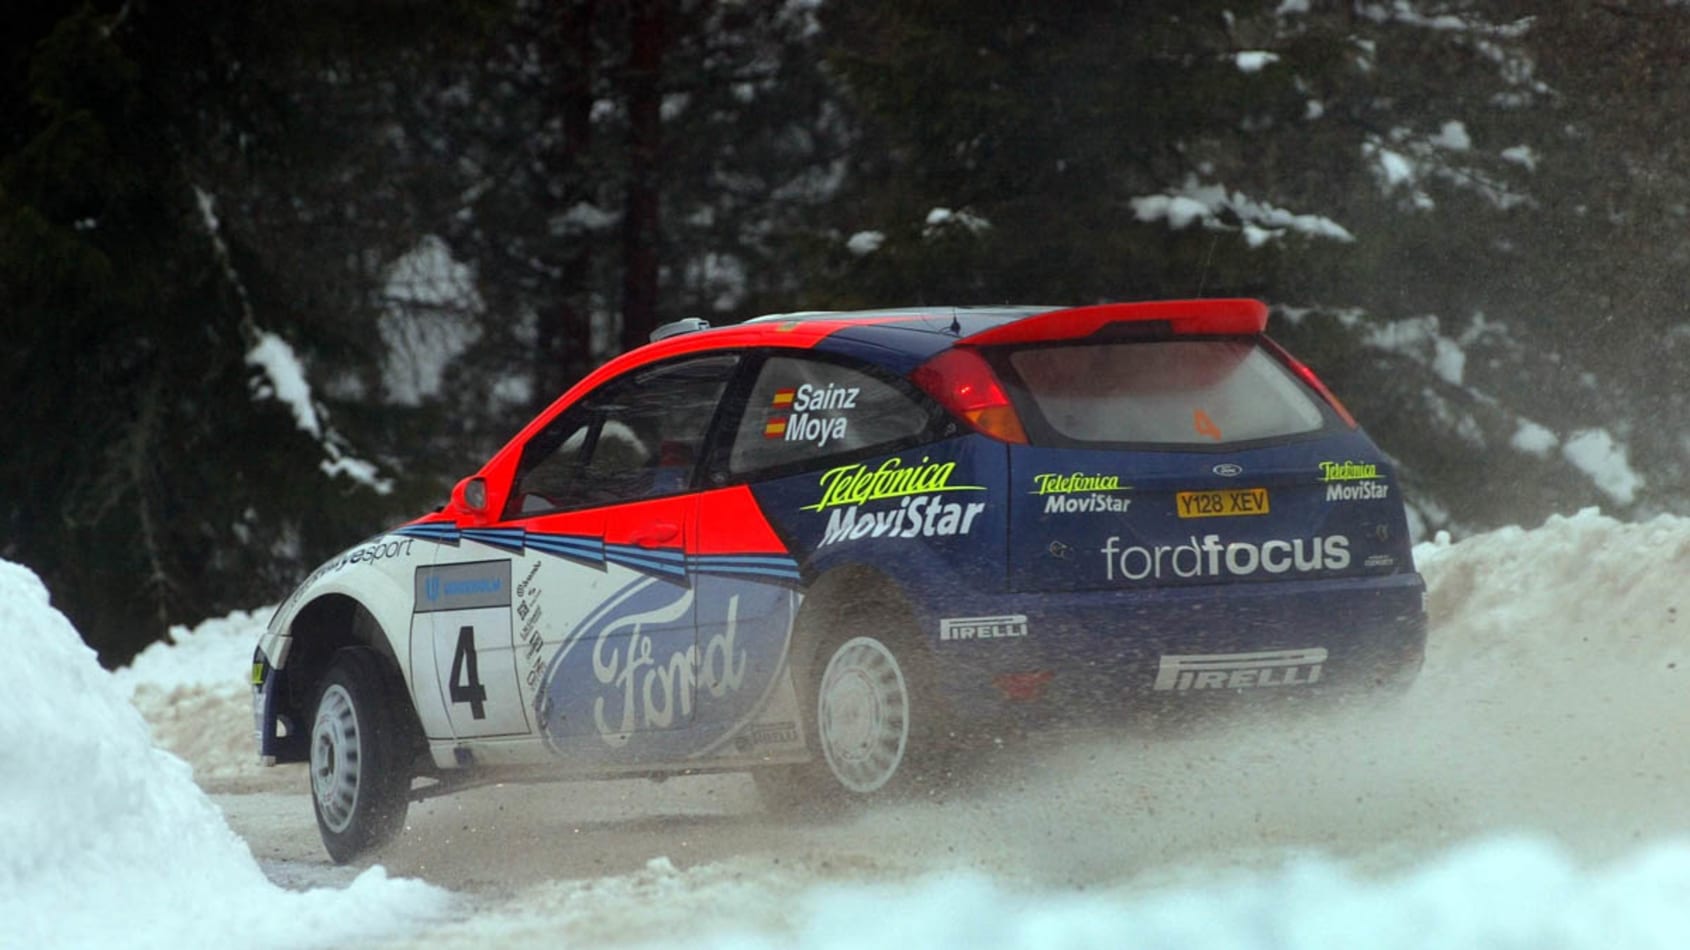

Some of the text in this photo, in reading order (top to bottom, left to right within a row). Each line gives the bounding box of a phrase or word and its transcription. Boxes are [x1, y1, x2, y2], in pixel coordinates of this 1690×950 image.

[793, 382, 860, 412] Sainz
[784, 412, 848, 447] Moya
[1192, 408, 1222, 442] 4
[1043, 493, 1131, 513] MoviStar
[1181, 492, 1264, 514] Y128 XEV
[1325, 480, 1389, 502] MoviStar
[812, 495, 985, 549] MoviStar
[940, 614, 1028, 640] PIRELLI
[449, 625, 488, 720] 4
[592, 588, 747, 748] Ford
[1153, 648, 1328, 691] PIRELLI
